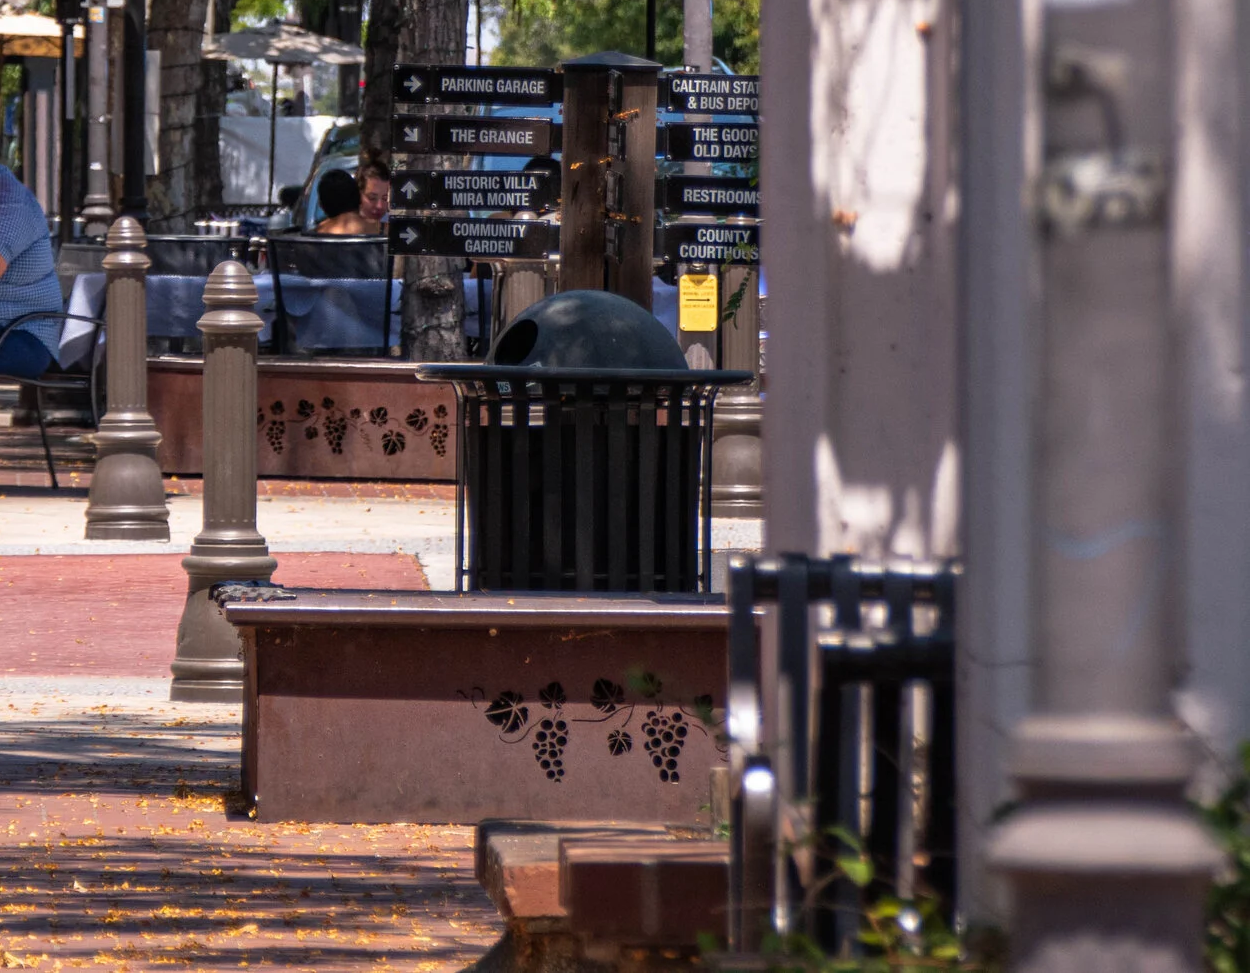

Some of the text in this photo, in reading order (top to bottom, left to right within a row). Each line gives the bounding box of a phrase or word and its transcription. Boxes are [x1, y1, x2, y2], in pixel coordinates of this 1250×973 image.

[441, 77, 546, 94] PARKING GARAGE
[672, 79, 760, 94] CALTRAIN STAT
[687, 96, 759, 111] & BUS DEPO
[450, 129, 534, 145] THE GRANGE
[693, 128, 759, 142] THE GOOD
[693, 144, 759, 159] OLD DAYS
[444, 176, 537, 190] HISTORIC VILLA
[452, 192, 529, 206] MIRA MONTE
[683, 188, 764, 204] RESTROOMS
[452, 222, 526, 238] COMMUNITY
[697, 228, 750, 243] COUNTY
[464, 239, 514, 254] GARDEN
[679, 244, 759, 260] COURTHOUS
